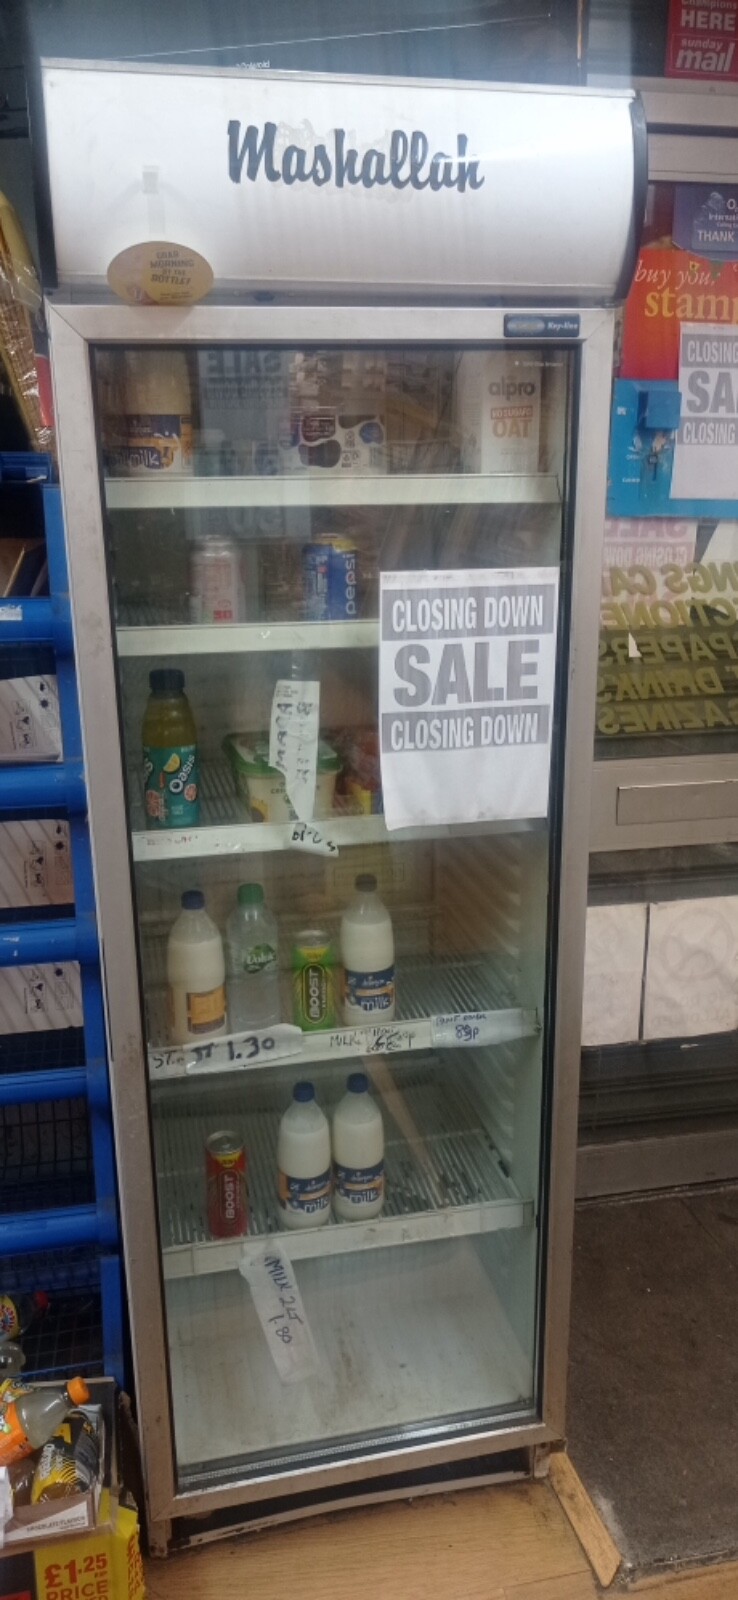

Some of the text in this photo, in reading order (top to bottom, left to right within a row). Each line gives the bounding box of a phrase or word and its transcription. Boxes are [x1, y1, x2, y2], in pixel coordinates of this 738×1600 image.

[681, 9, 736, 32] HERE
[675, 42, 735, 72] mail
[681, 38, 723, 52] sunday
[227, 119, 485, 193] Mashallah
[697, 229, 735, 243] THANK
[634, 260, 671, 290] buy
[488, 375, 535, 401] alpro
[686, 370, 738, 414] SA
[492, 418, 532, 438] OAT
[683, 421, 736, 444] CLOSING
[341, 553, 357, 615] pepsi
[392, 595, 543, 632] CLOSING DOWN
[393, 639, 540, 707] SALE
[391, 713, 538, 751] CLOSING DOWN
[169, 754, 195, 793] Oasis
[309, 967, 320, 1018] BOOST
[360, 996, 389, 1012] milk
[227, 1036, 275, 1061] 1.30
[225, 1175, 235, 1219] BOOST
[304, 1198, 329, 1213] milk
[350, 1189, 377, 1204] milk
[44, 1552, 108, 1589] £1.25
[46, 1580, 110, 1600] PRICE
